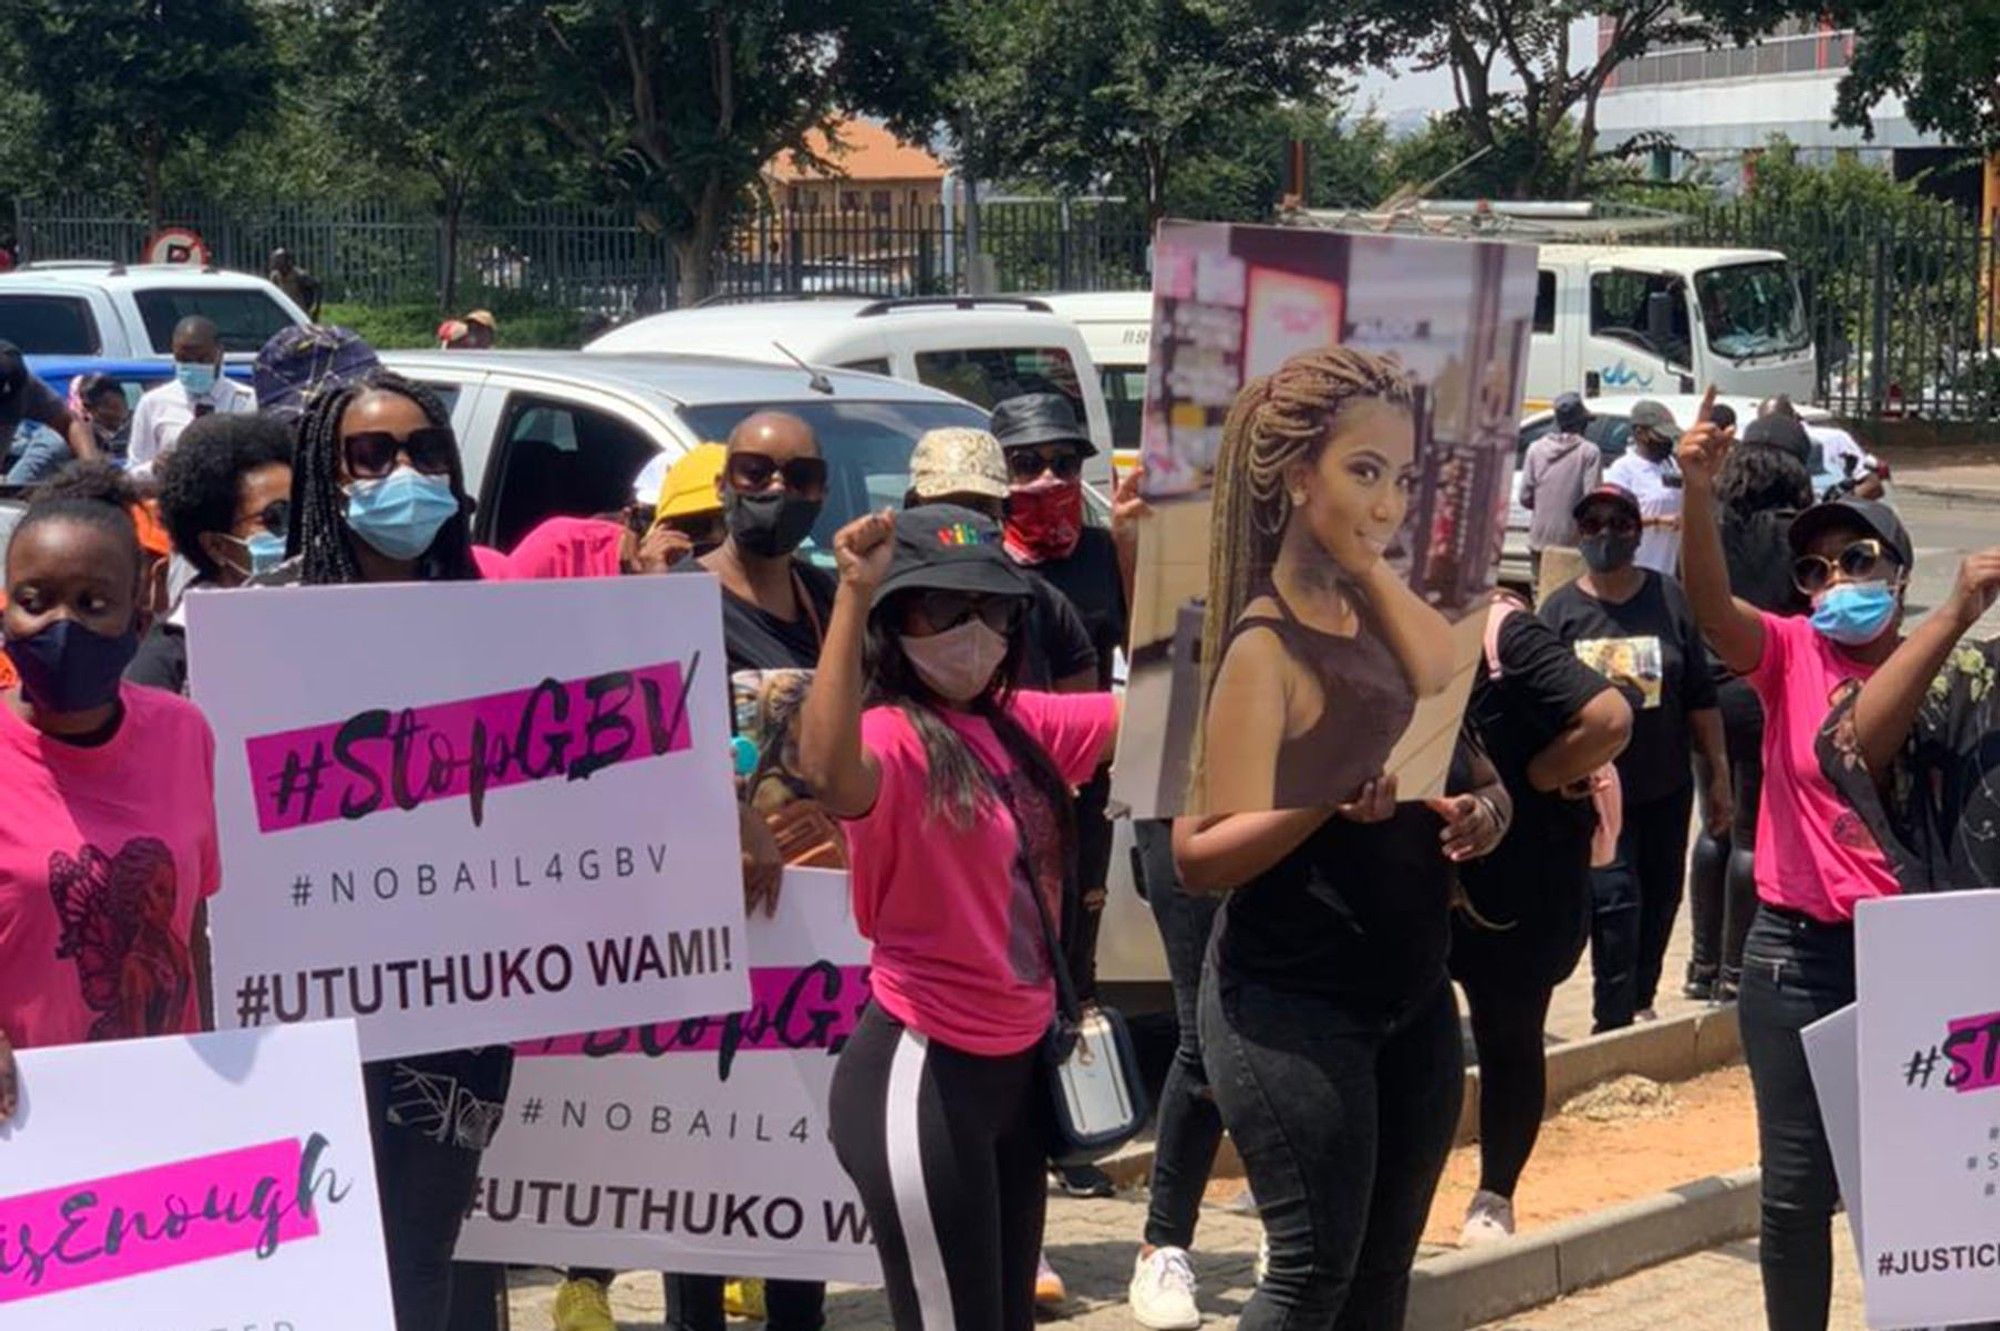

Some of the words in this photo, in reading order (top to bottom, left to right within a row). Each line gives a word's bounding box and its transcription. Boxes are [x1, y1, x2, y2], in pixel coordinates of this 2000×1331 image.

[268, 650, 700, 828] #StopGBV
[290, 844, 667, 907] #NOBAIL4GBV
[236, 943, 573, 1028] #UTUTHUKO
[587, 925, 733, 987] WAMI!
[1878, 1242, 2000, 1276] #JUSTIC
